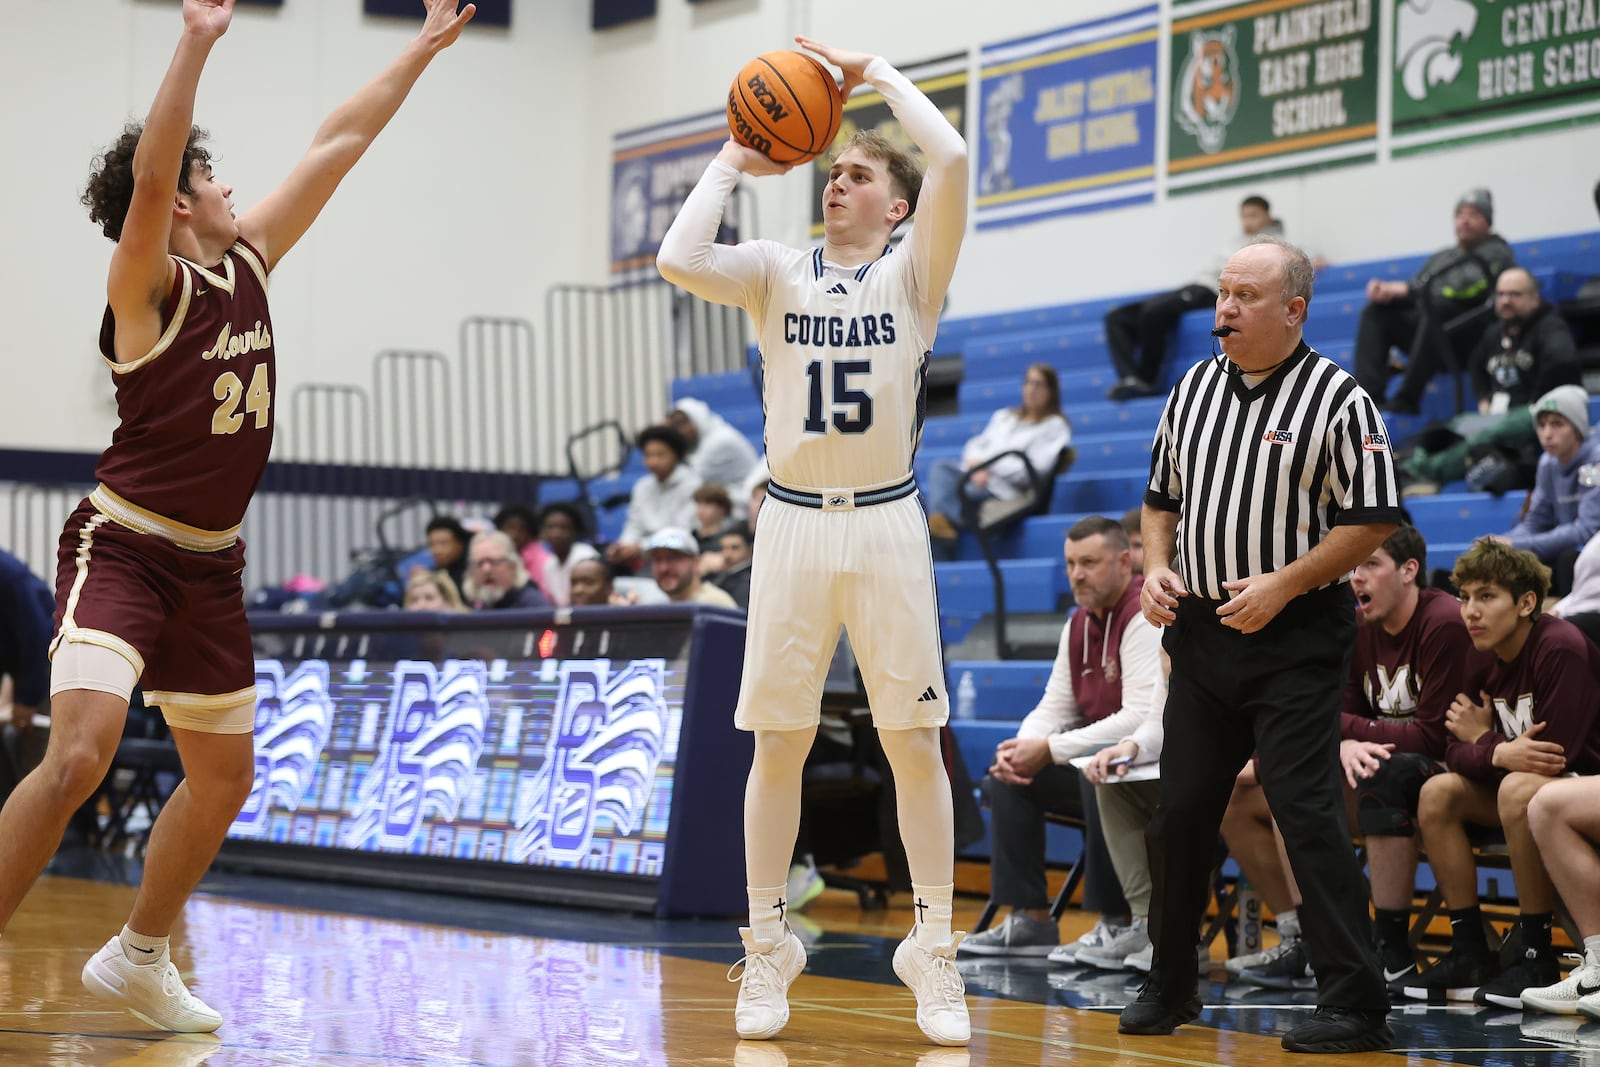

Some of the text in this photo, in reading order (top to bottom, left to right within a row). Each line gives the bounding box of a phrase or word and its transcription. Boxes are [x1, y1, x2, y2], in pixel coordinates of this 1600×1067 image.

[1253, 0, 1371, 54] PLAINFIELD
[1501, 0, 1600, 47] CENTRA
[1258, 40, 1364, 97] EAST HIGH
[1478, 51, 1534, 100] HIGH
[748, 74, 788, 122] NCAA
[1272, 89, 1347, 137] SCHOOL
[784, 312, 896, 347] COUGARS
[211, 363, 271, 434] 24
[803, 359, 874, 435] 15
[1245, 899, 1258, 949] core
